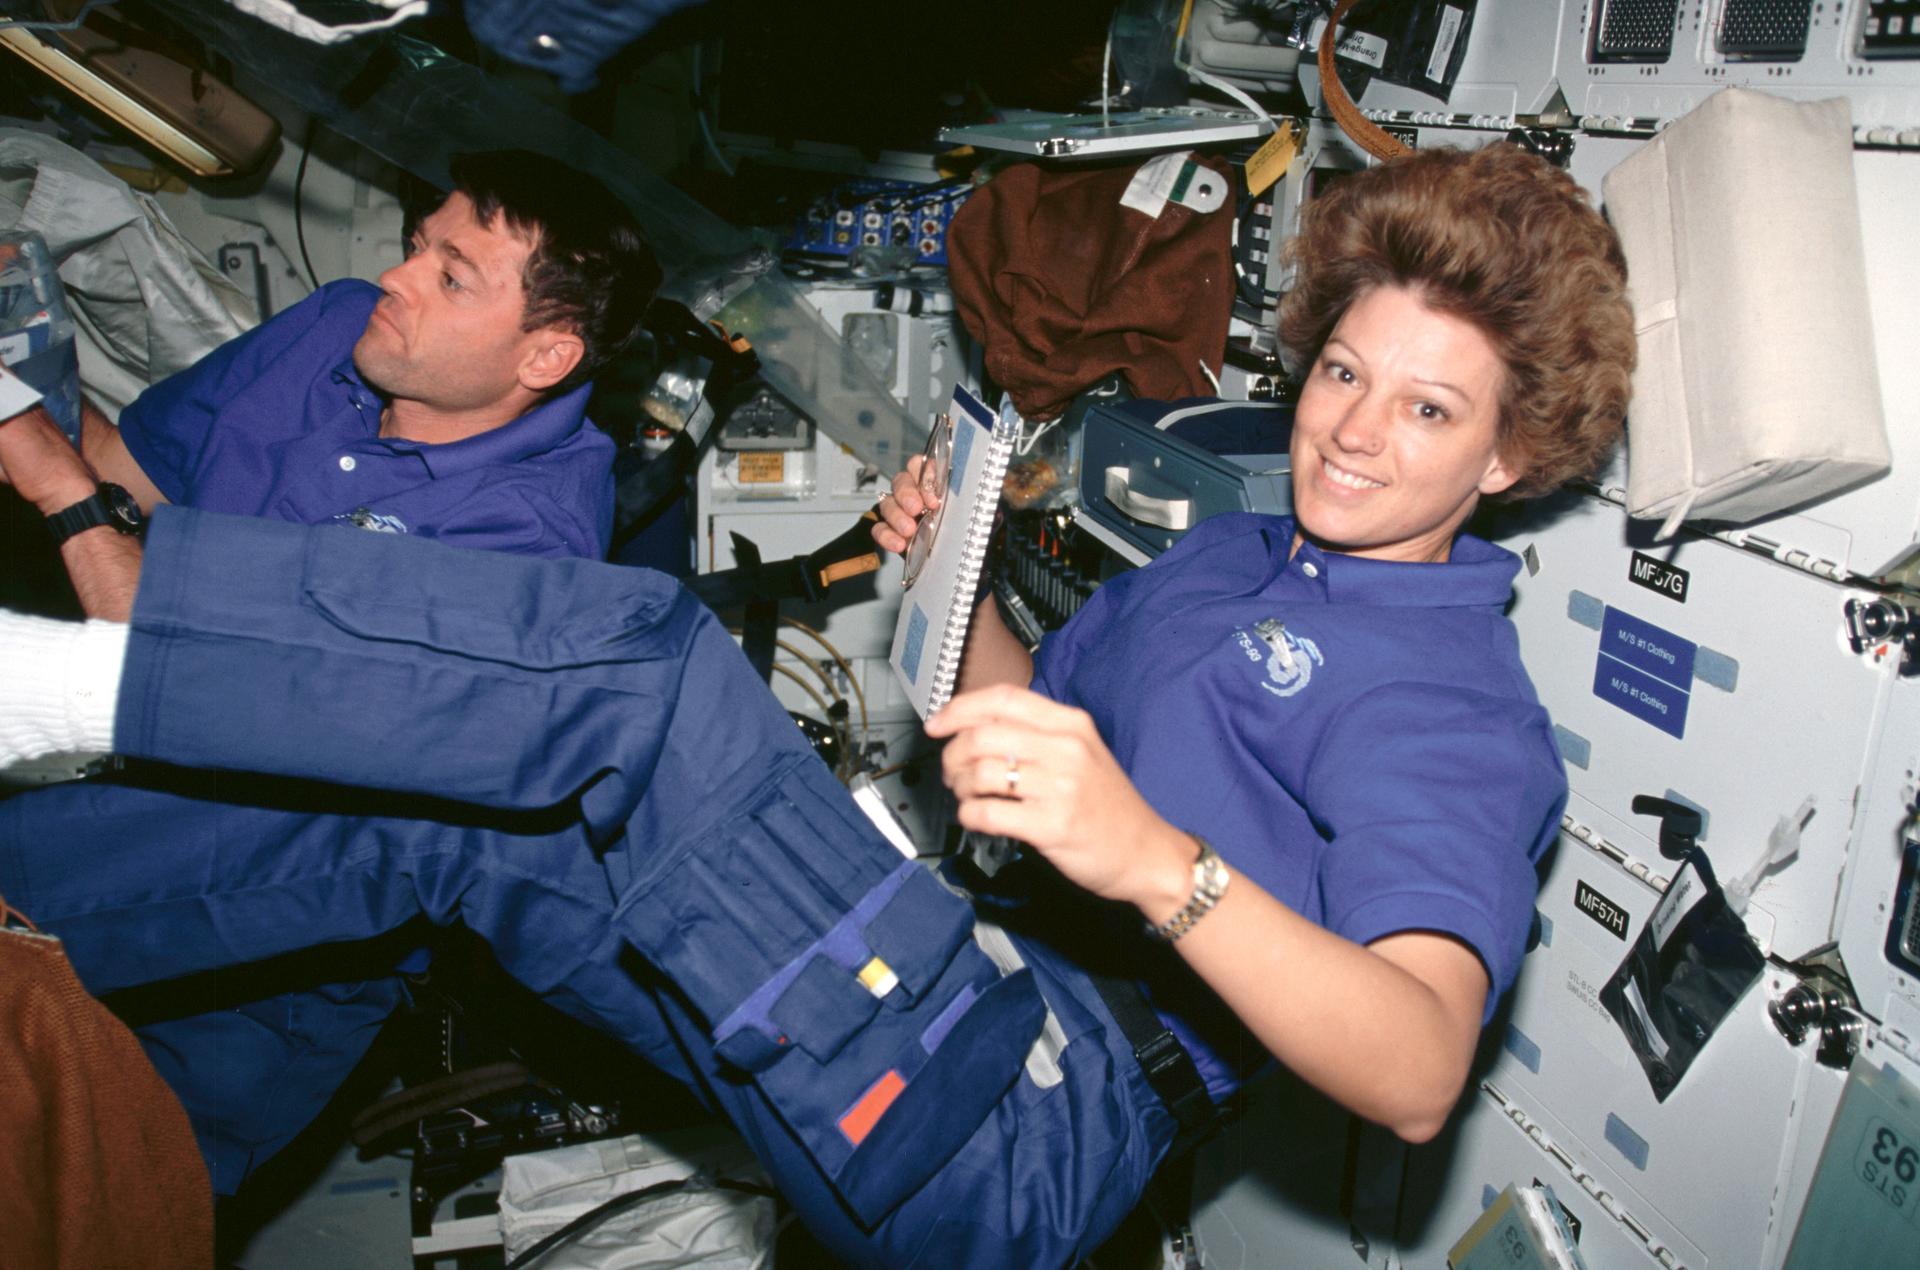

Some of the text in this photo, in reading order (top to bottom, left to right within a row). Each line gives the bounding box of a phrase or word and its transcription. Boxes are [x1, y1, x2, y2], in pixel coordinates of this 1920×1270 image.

[1634, 558, 1684, 595] MF57G
[1618, 629, 1676, 665] M/S #1 Clothing
[1611, 677, 1668, 715] M/S #1 Clothing
[1579, 887, 1624, 932] MF57H
[1872, 1126, 1920, 1184] 93
[1862, 1160, 1907, 1208] STS
[1504, 1225, 1526, 1260] 93
